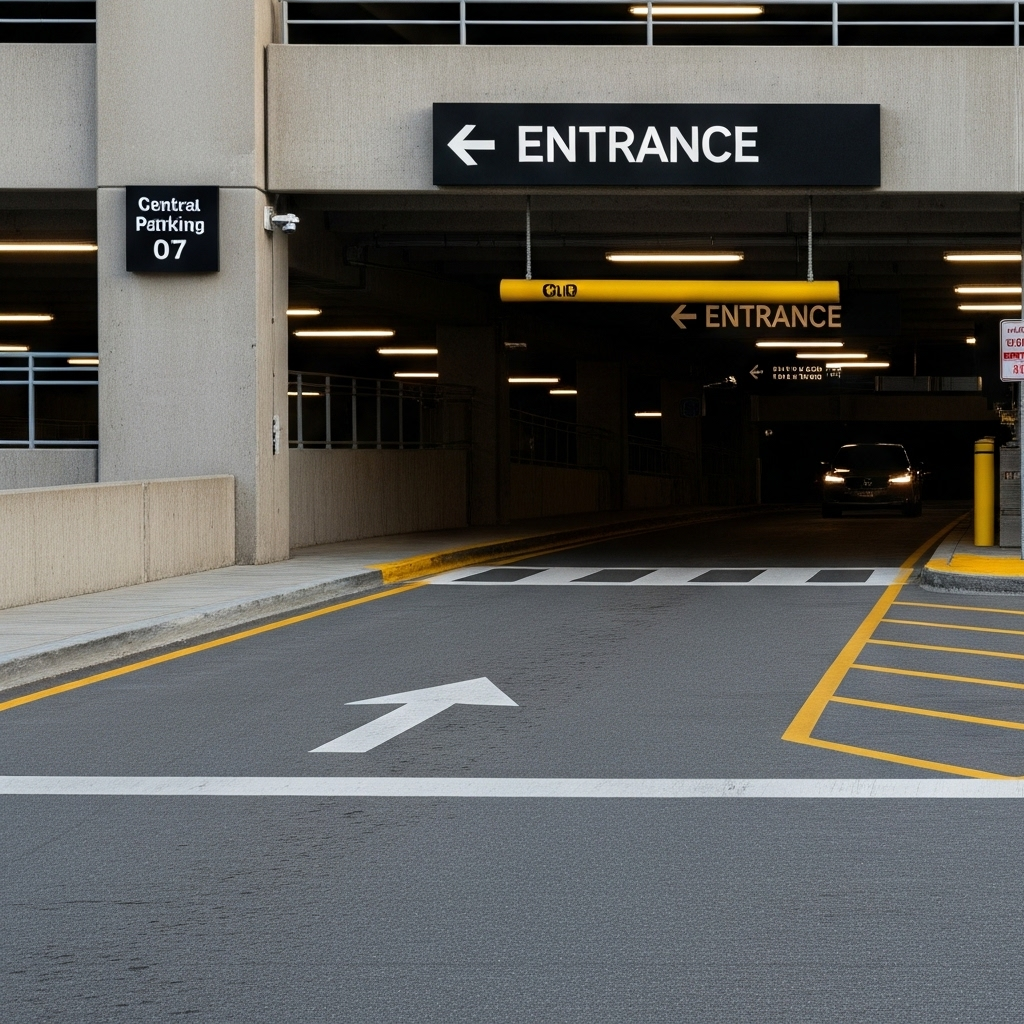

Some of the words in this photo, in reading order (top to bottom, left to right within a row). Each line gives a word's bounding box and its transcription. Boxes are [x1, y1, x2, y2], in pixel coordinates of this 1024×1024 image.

[518, 125, 760, 164] ENTRANCE
[138, 196, 201, 212] Central
[153, 238, 187, 260] 07
[705, 304, 842, 328] ENTRANCE
